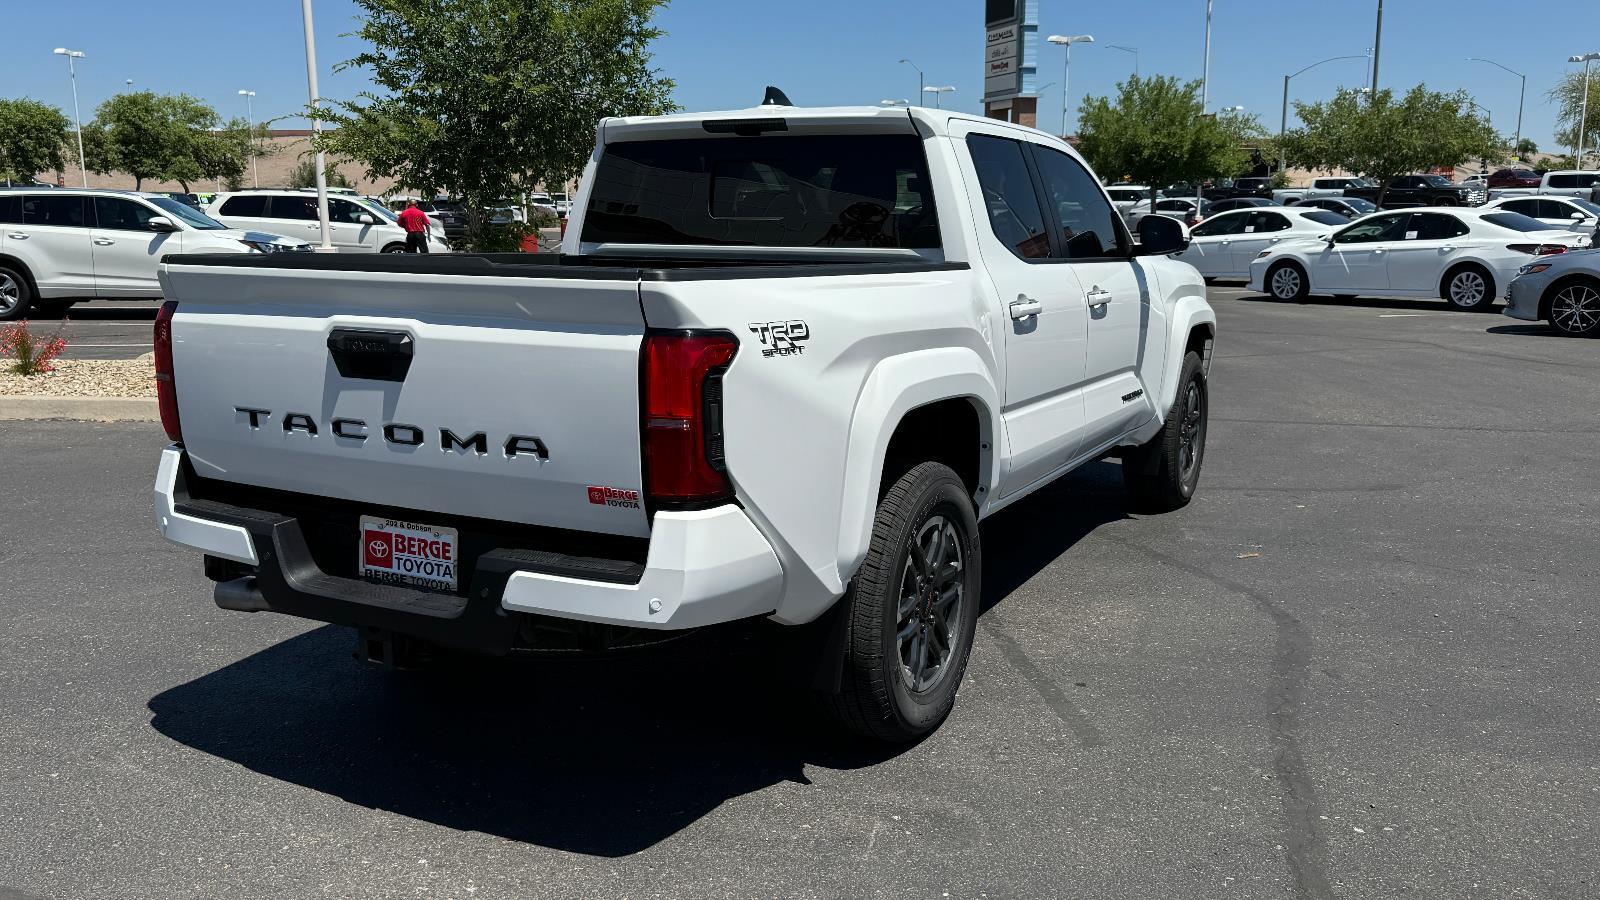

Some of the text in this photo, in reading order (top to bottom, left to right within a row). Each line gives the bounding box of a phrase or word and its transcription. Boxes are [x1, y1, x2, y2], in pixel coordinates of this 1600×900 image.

[748, 319, 810, 349] TRD
[761, 345, 805, 358] SPORT
[233, 406, 550, 461] TACOMA
[604, 486, 638, 500] BERGE
[606, 499, 640, 509] TOYOTA
[385, 519, 398, 527] 202
[407, 523, 432, 533] Dobson
[394, 533, 452, 560] BERGE
[394, 556, 453, 579] TOYOTA
[365, 568, 451, 590] BERGE TOYOTA
